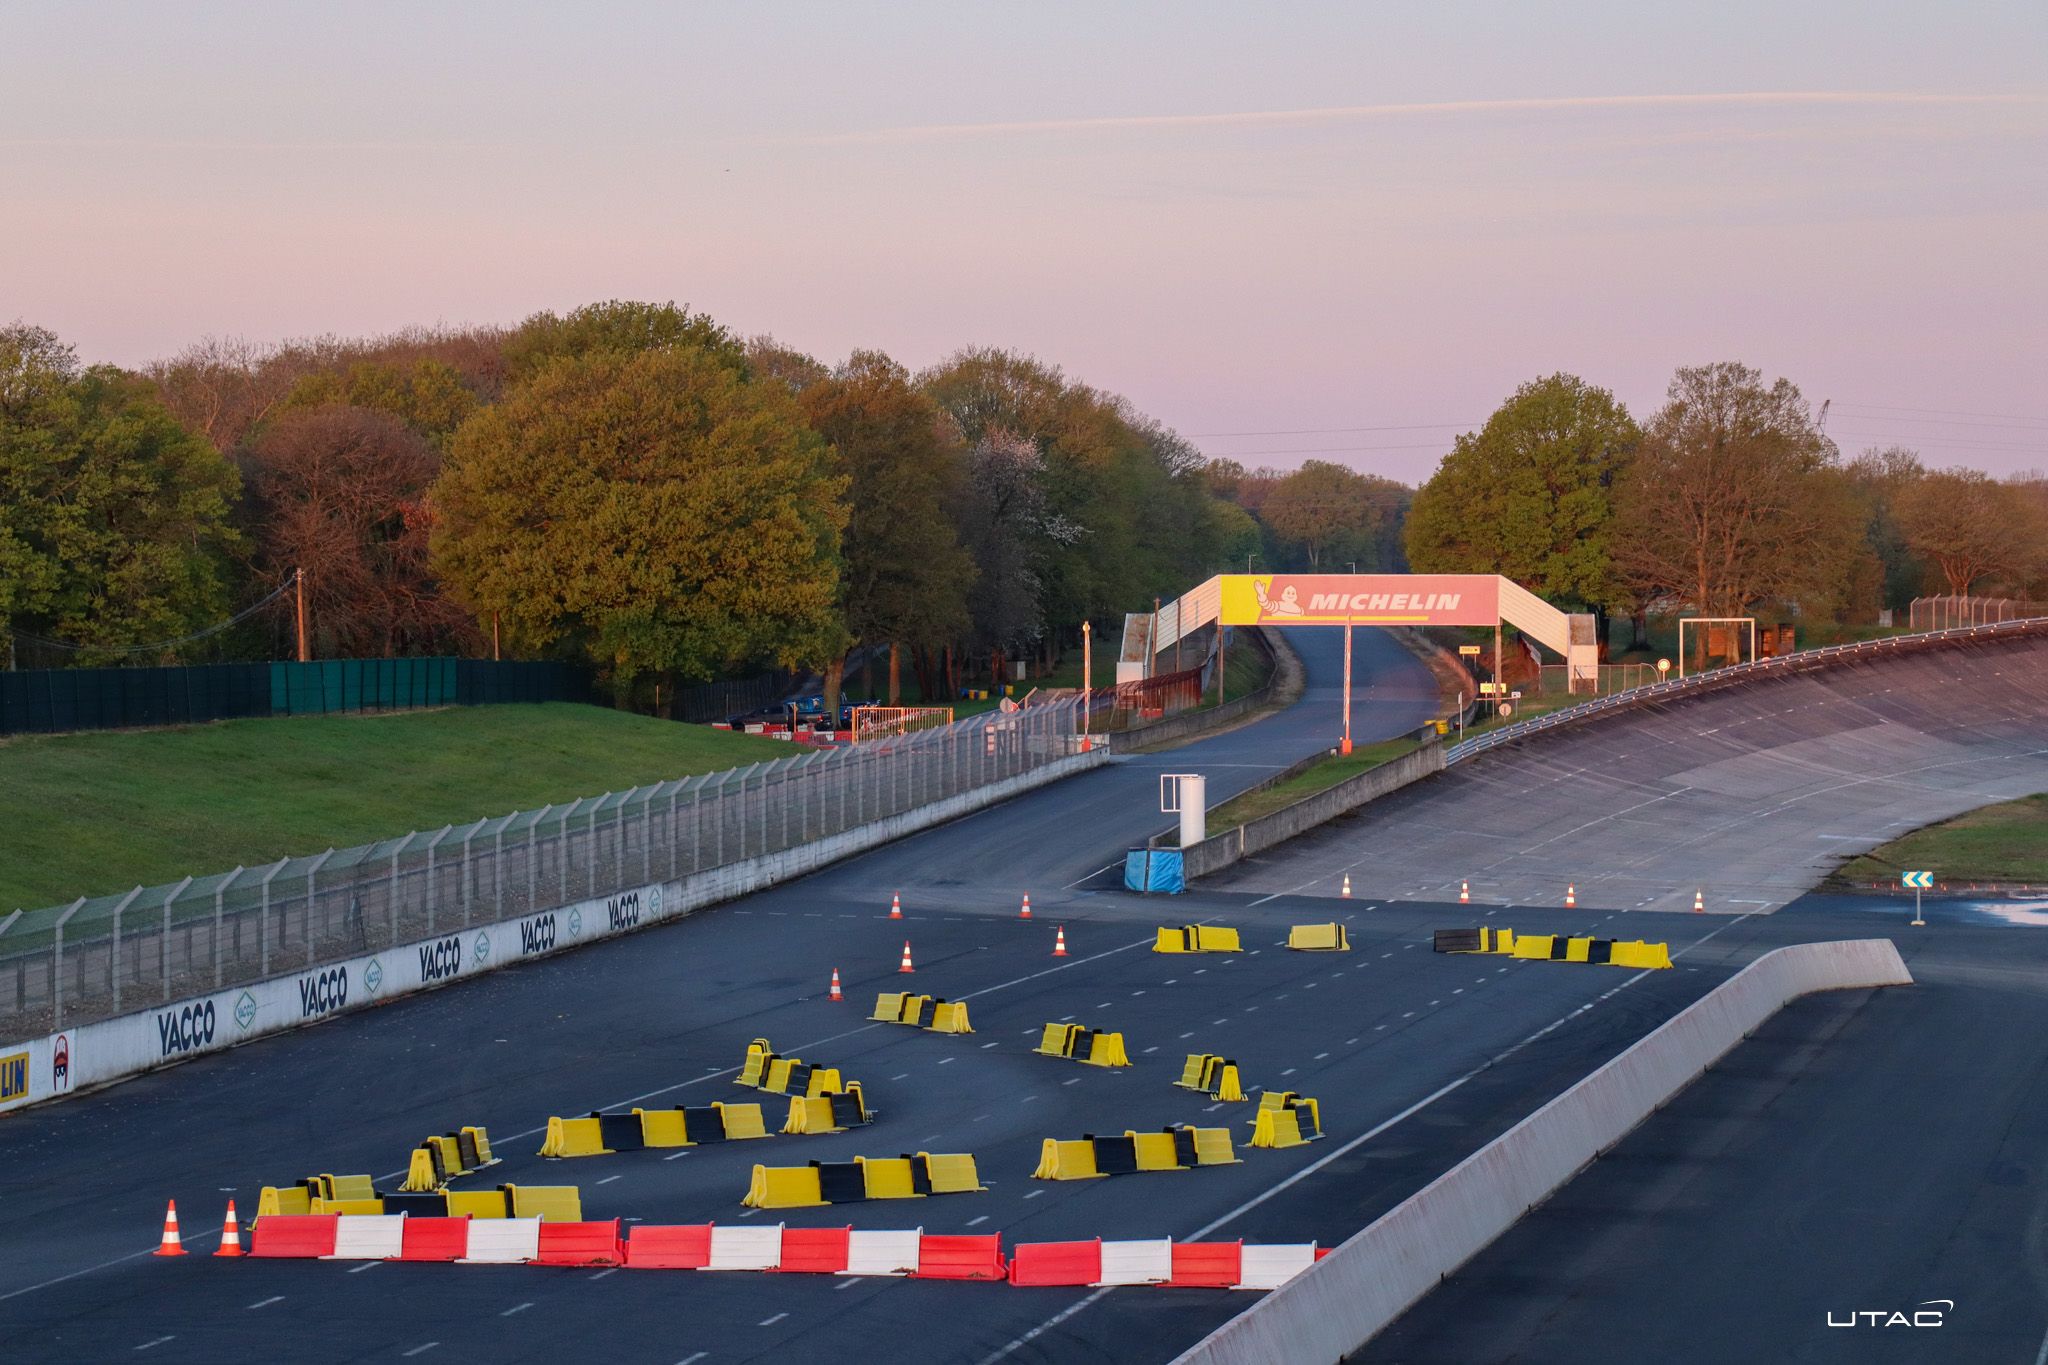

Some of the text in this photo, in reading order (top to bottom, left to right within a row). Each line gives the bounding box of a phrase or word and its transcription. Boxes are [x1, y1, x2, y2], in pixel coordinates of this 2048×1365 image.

[1309, 593, 1461, 610] MICHELIN
[608, 892, 639, 931] YACCO
[521, 913, 555, 955] YACCO
[419, 937, 460, 982] YACCO
[299, 966, 347, 1017] YACCO
[158, 1000, 215, 1056] YACCO
[1, 1058, 25, 1097] LIN
